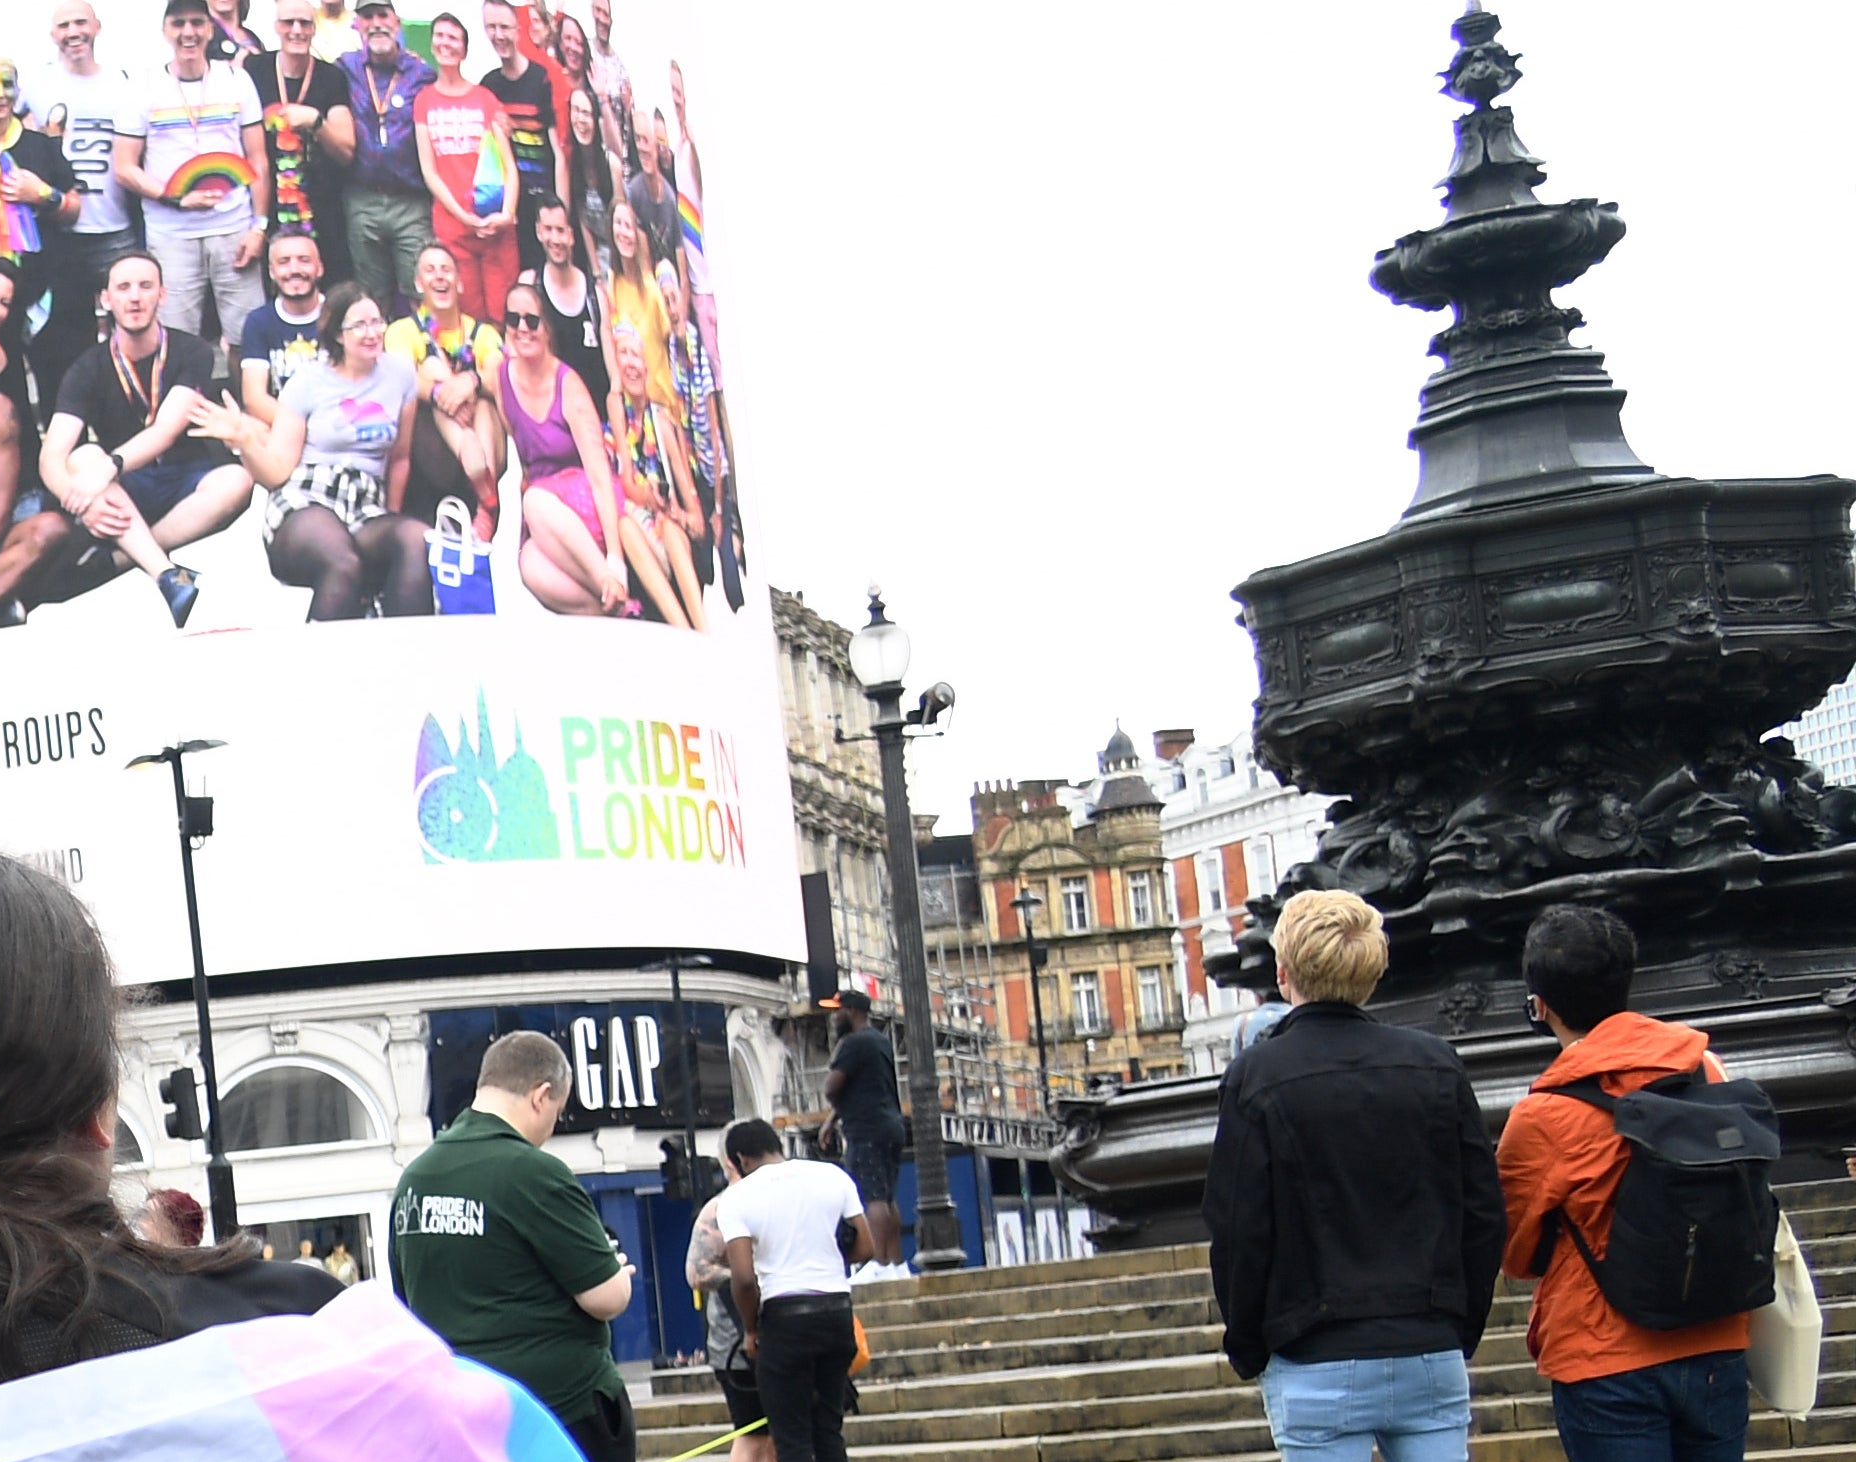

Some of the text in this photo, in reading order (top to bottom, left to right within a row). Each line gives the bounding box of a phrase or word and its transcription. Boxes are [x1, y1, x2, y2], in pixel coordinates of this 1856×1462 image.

[560, 716, 740, 799] PRIDE IN
[570, 792, 746, 869] LONDON
[571, 1015, 661, 1111] GAP
[421, 1195, 483, 1217] PRIDE IN
[421, 1214, 484, 1236] LONDON
